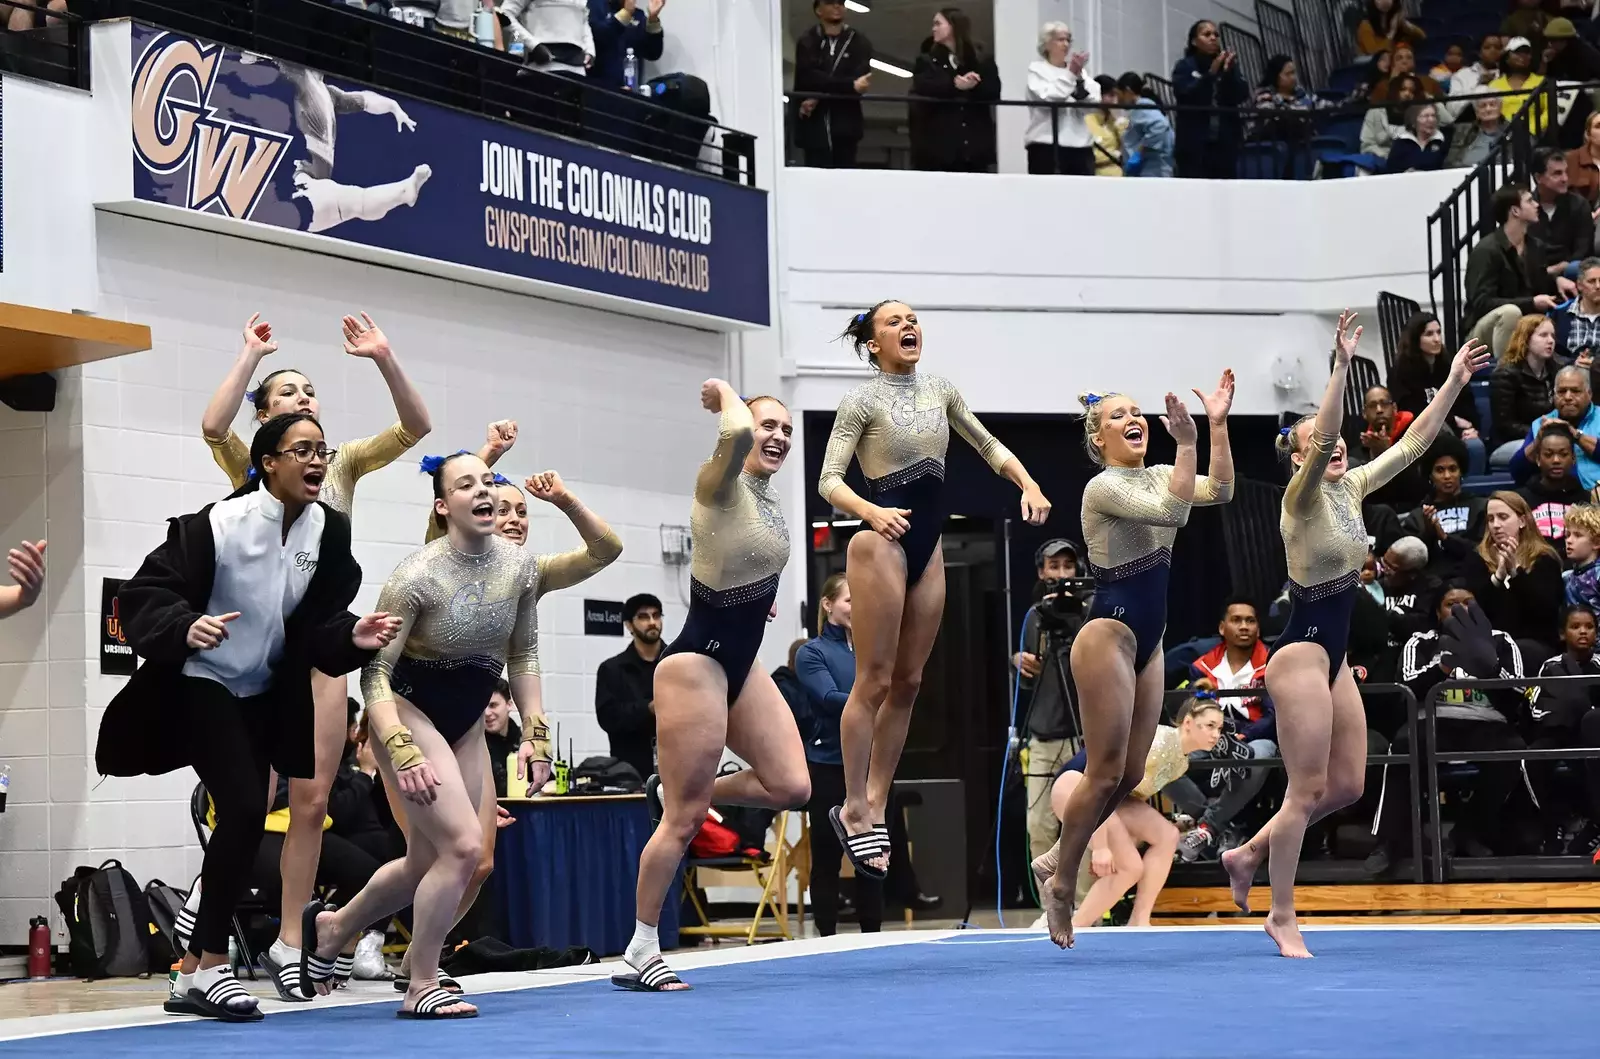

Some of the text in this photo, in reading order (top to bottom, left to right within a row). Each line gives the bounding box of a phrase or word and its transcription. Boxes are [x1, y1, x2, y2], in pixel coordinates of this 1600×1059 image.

[480, 140, 711, 245] JOIN THE COLONIALS CLUB
[485, 205, 709, 292] GWSPORTS.COM/COLONIALSCLUB
[605, 610, 622, 624] Level
[104, 644, 133, 655] URSINUS
